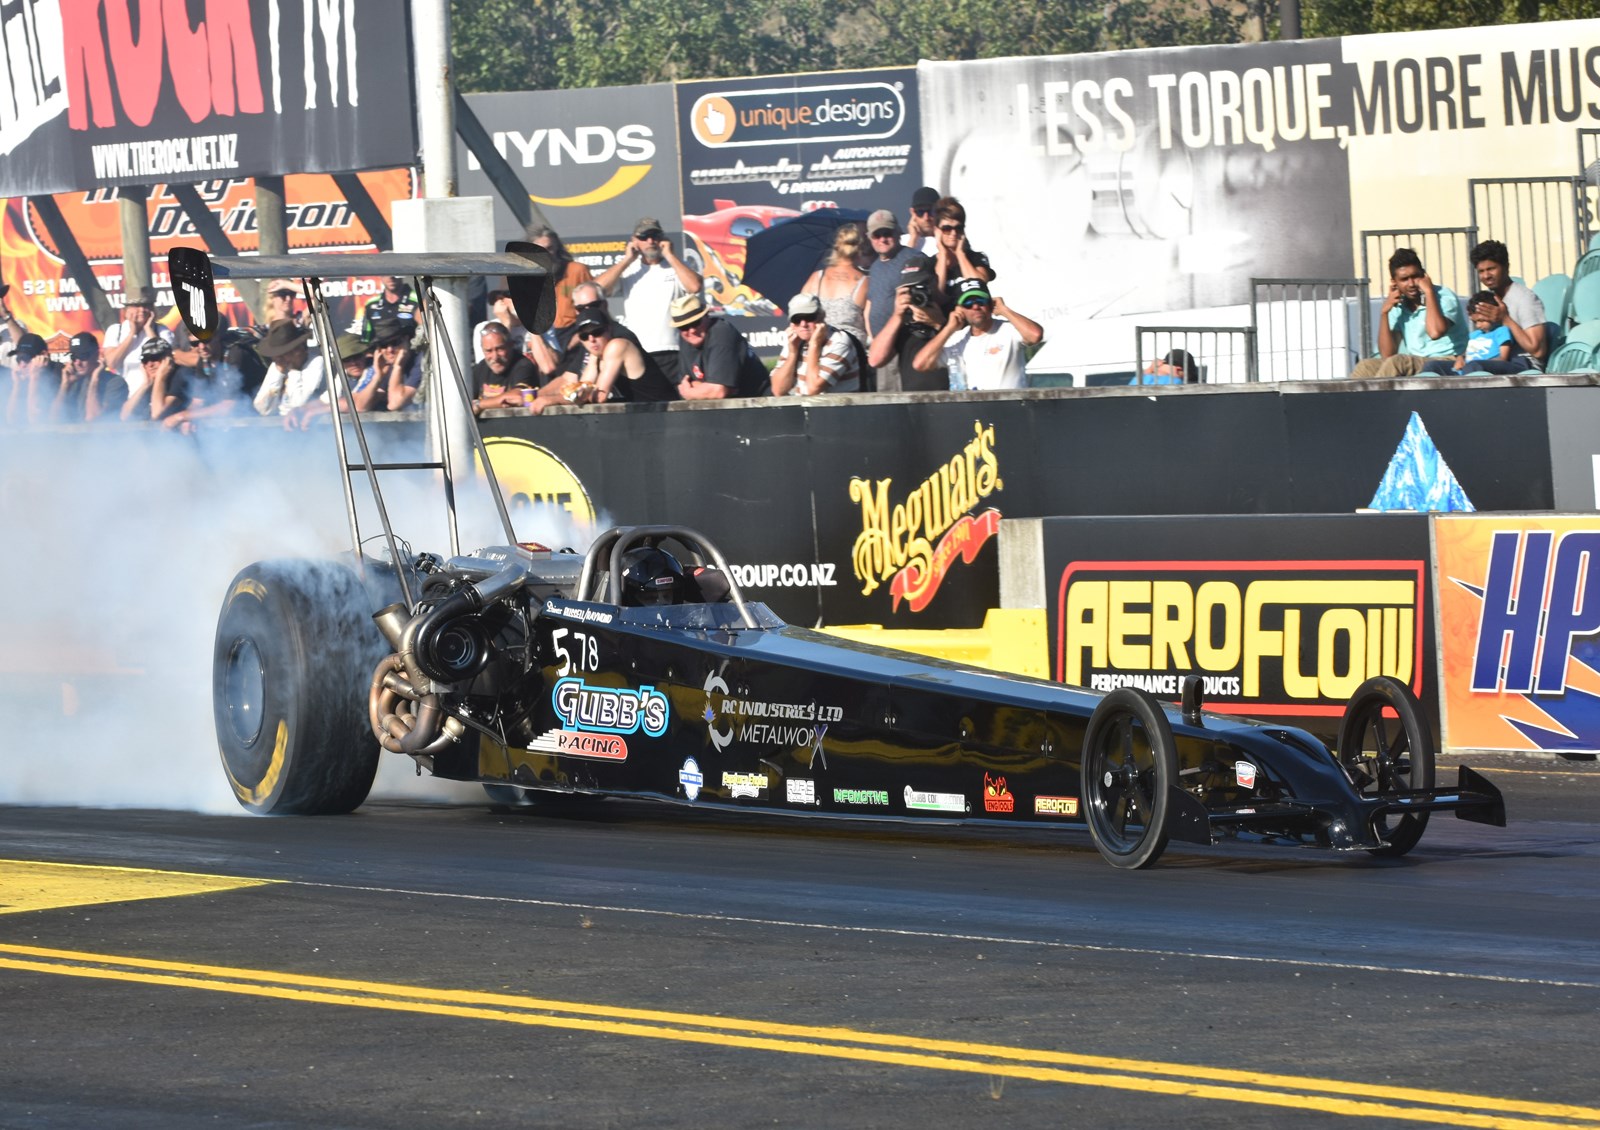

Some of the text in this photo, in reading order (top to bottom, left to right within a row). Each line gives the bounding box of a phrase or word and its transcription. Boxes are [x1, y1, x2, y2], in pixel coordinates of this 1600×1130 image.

[1017, 77, 1136, 157] LESS
[1148, 63, 1350, 152] TORQUE,
[1344, 53, 1486, 137] MORE
[92, 134, 239, 179] WWW.THEROCK.NET.NZ
[23, 279, 55, 295] 521
[727, 563, 838, 588] ROUP.CO.NZ
[552, 628, 599, 677] 5.78
[1065, 580, 1414, 699] AEROFLOW
[1091, 674, 1240, 696] PERFORMANCE PDUCTS
[556, 682, 666, 732] GUBB'S
[817, 706, 843, 722] LTD
[558, 734, 620, 755] RACING
